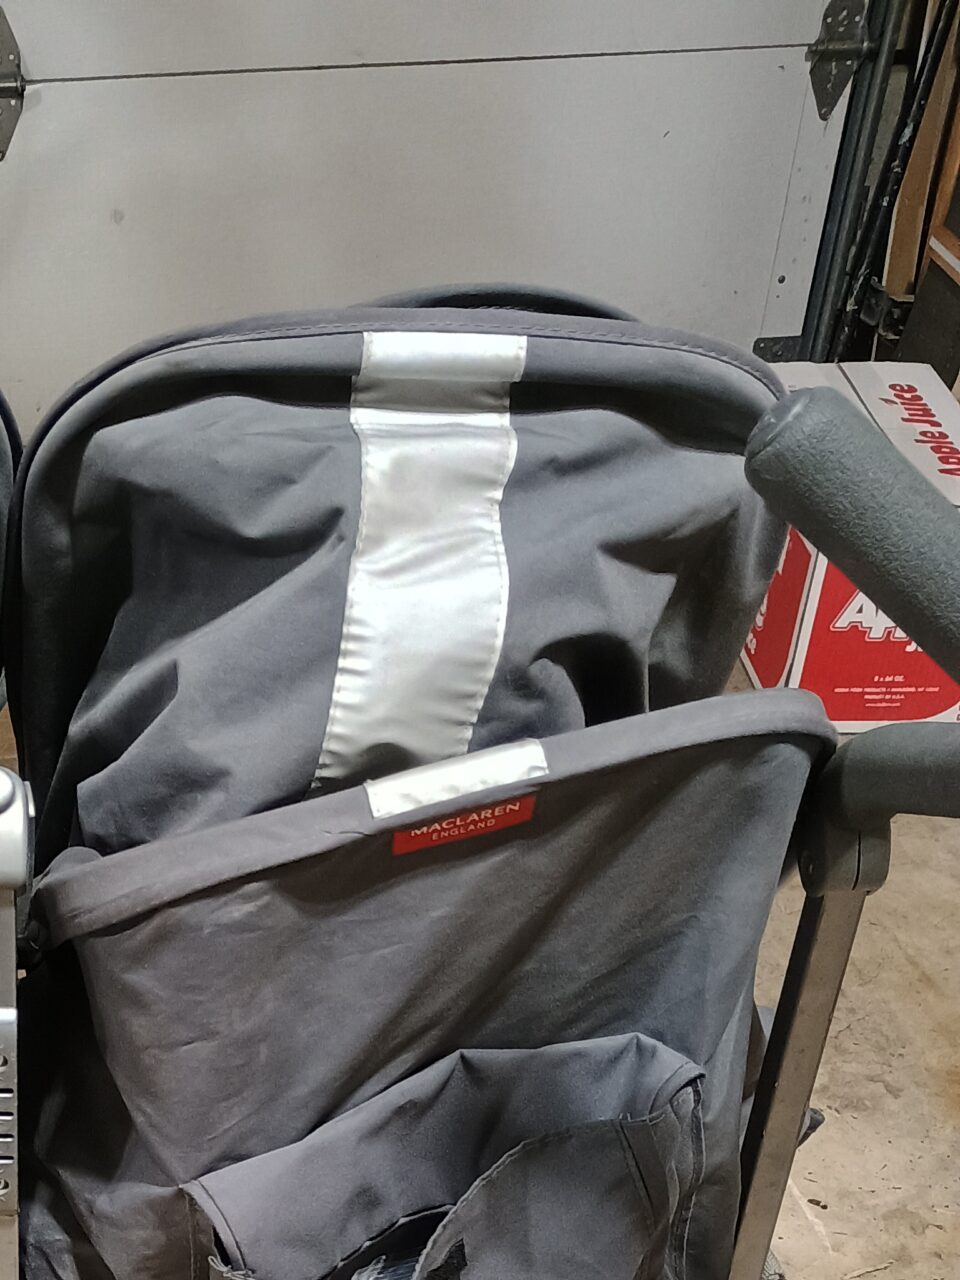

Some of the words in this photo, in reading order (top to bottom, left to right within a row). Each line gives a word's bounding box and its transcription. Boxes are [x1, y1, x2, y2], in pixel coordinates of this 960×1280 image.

[878, 383, 942, 428] Juice
[410, 801, 521, 837] MACLAREN
[431, 818, 496, 841] ENGLAND
